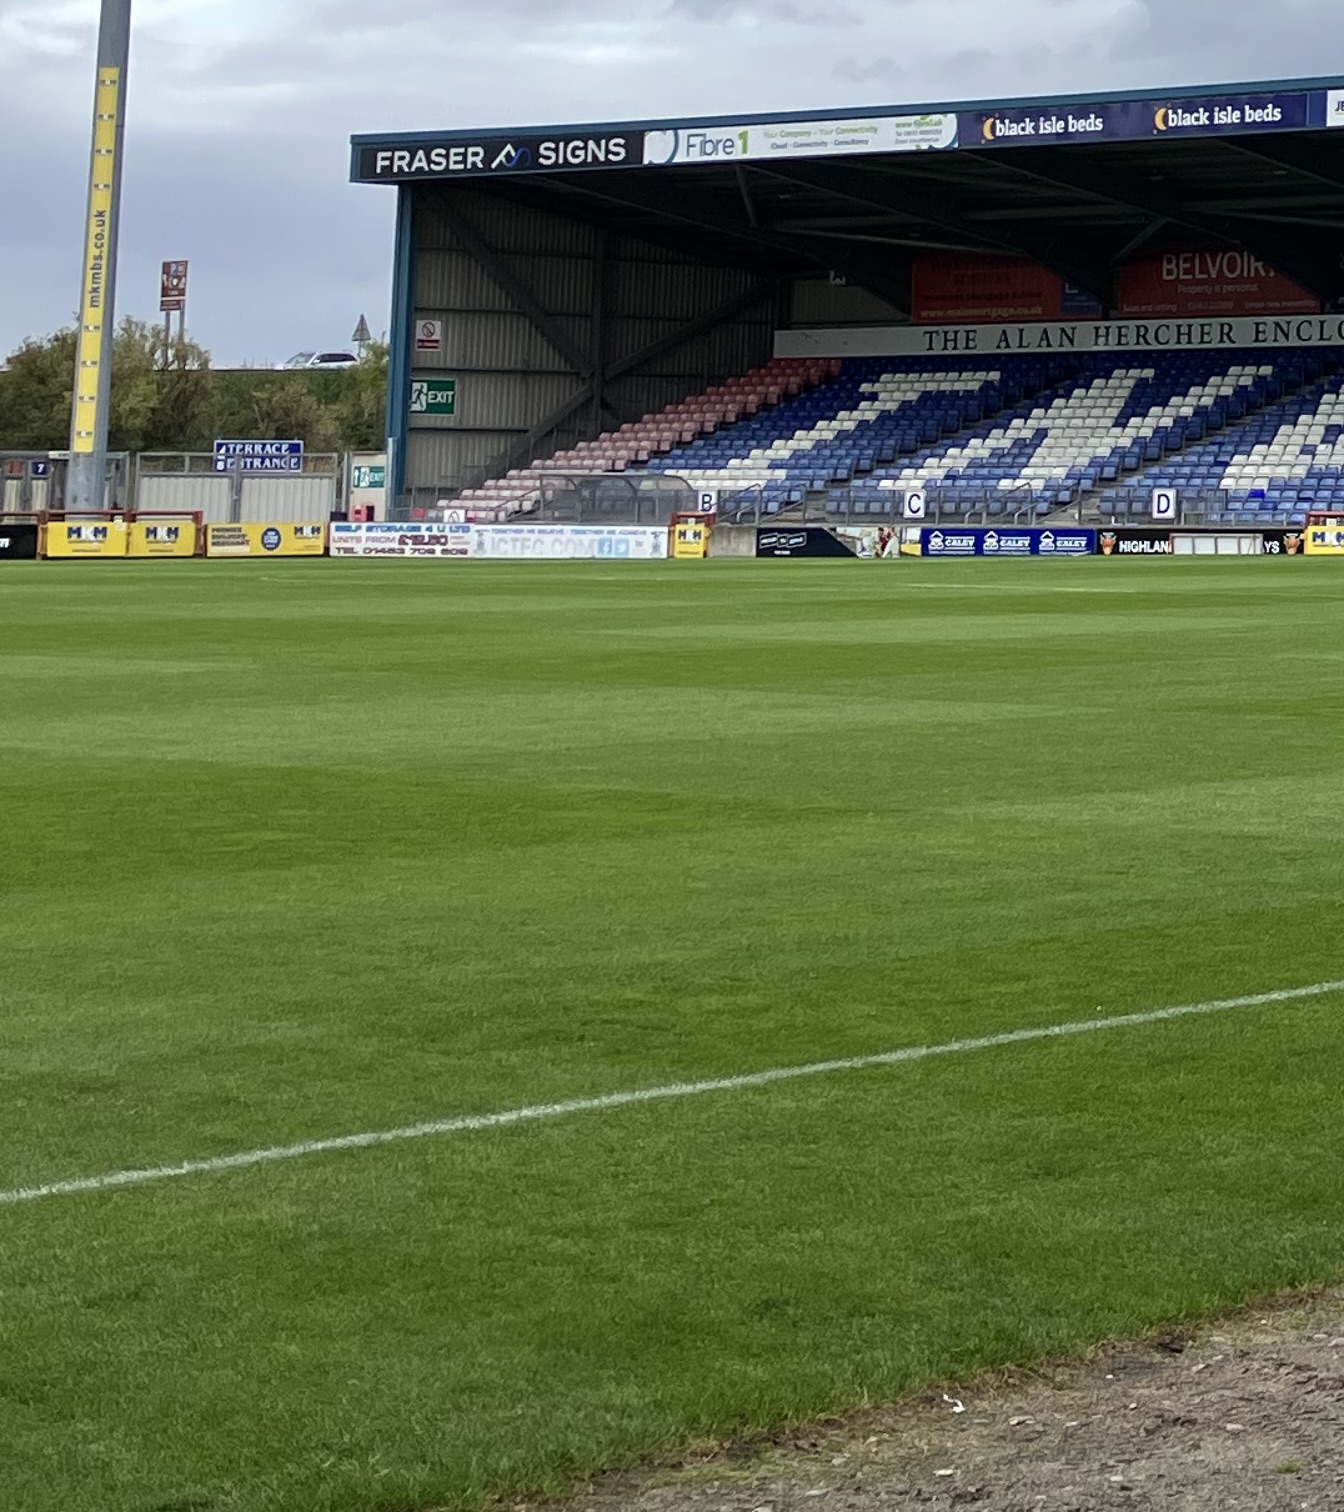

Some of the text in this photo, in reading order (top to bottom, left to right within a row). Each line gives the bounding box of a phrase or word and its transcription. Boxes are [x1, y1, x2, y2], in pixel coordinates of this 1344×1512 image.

[1167, 105, 1282, 126] black isle beds
[995, 114, 1104, 137] black isle beds
[375, 137, 626, 174] FRASER SIGNS
[88, 209, 107, 309] mkmbs.co.uk
[924, 329, 977, 352] THE
[996, 326, 1077, 350] ALAN
[1092, 322, 1237, 348] HERCHER
[427, 390, 454, 404] EXIT
[228, 443, 290, 455] TERRACE
[227, 457, 298, 470] ETRANCE
[701, 494, 712, 512] B
[908, 493, 922, 514] C
[1157, 493, 1170, 513] D
[67, 526, 108, 541] MKM
[145, 526, 180, 540] MKM
[945, 538, 975, 547] CALEY
[1000, 538, 1031, 547] CALEY
[1056, 539, 1087, 547] CALEY
[1118, 540, 1170, 554] HIGHLAN
